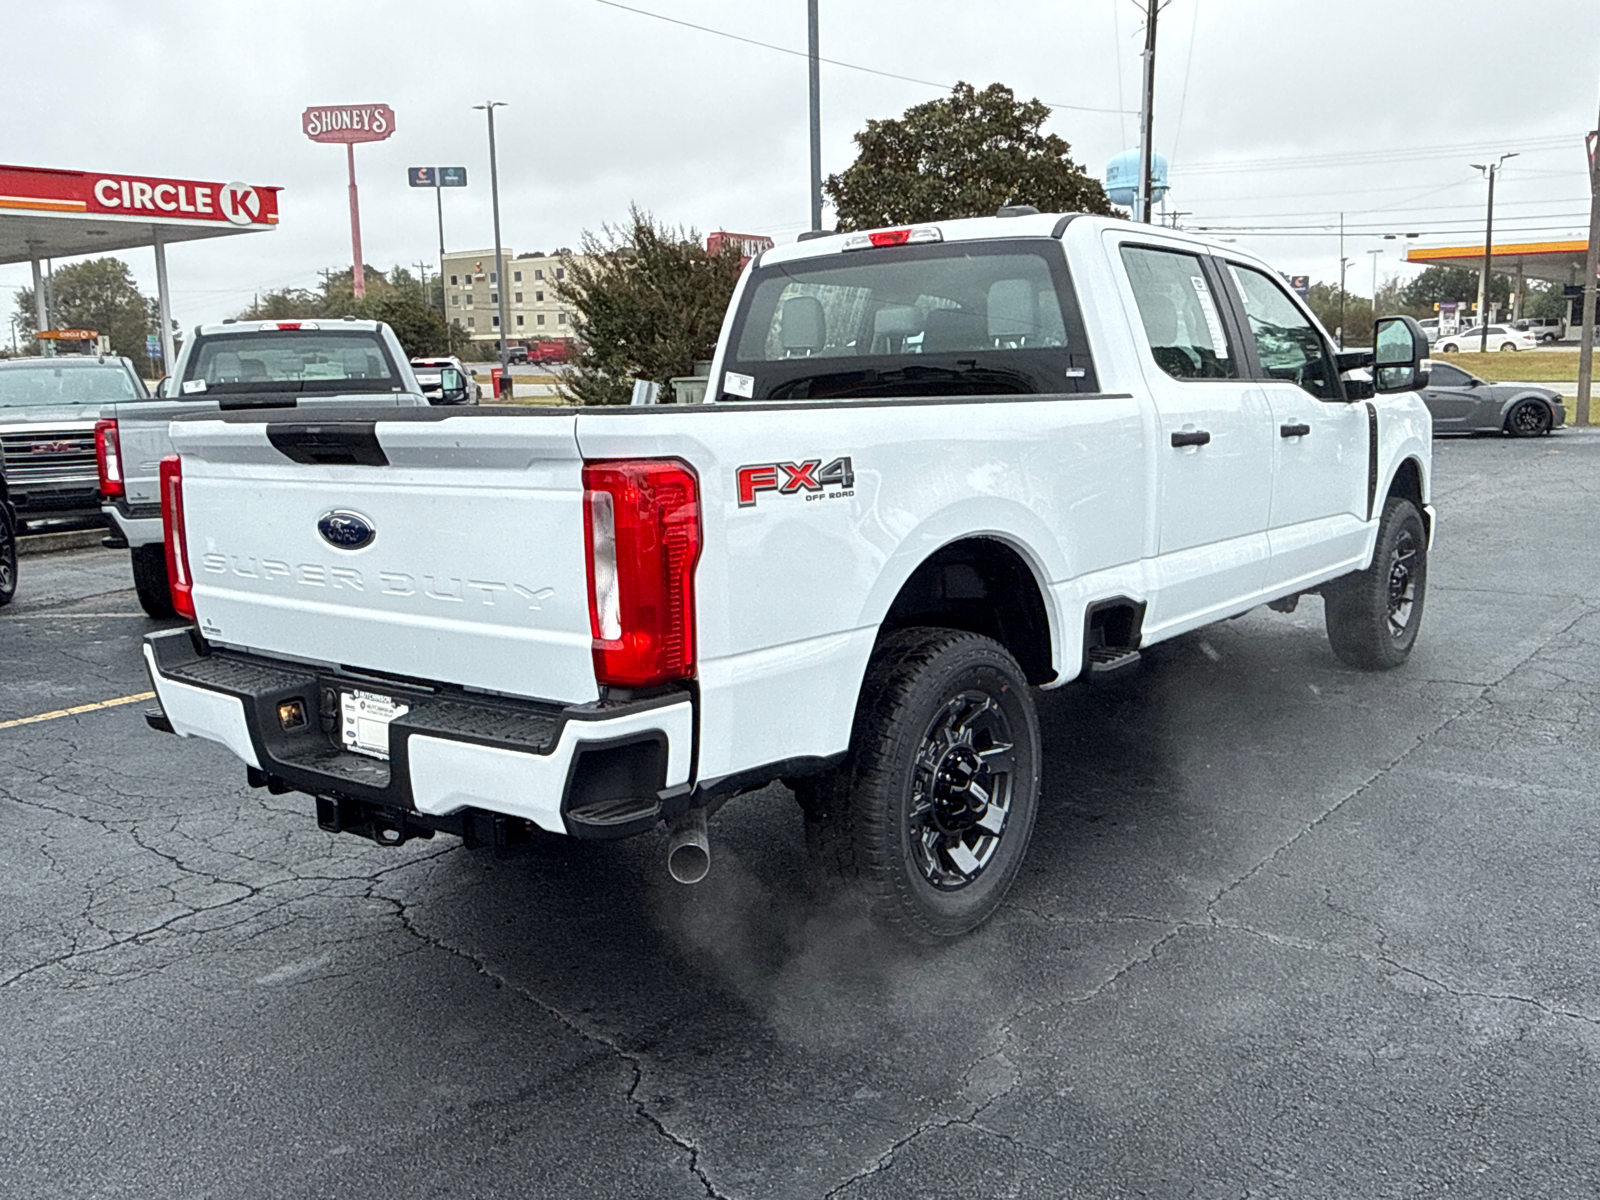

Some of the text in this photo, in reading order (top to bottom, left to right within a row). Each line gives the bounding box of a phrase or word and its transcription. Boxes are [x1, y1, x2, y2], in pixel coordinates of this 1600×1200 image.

[307, 106, 387, 136] SHONEY'S
[94, 179, 257, 223] CIRCLE K
[735, 456, 855, 509] FX4
[805, 490, 855, 502] OFF ROAD
[203, 553, 555, 611] SUPER DUTY
